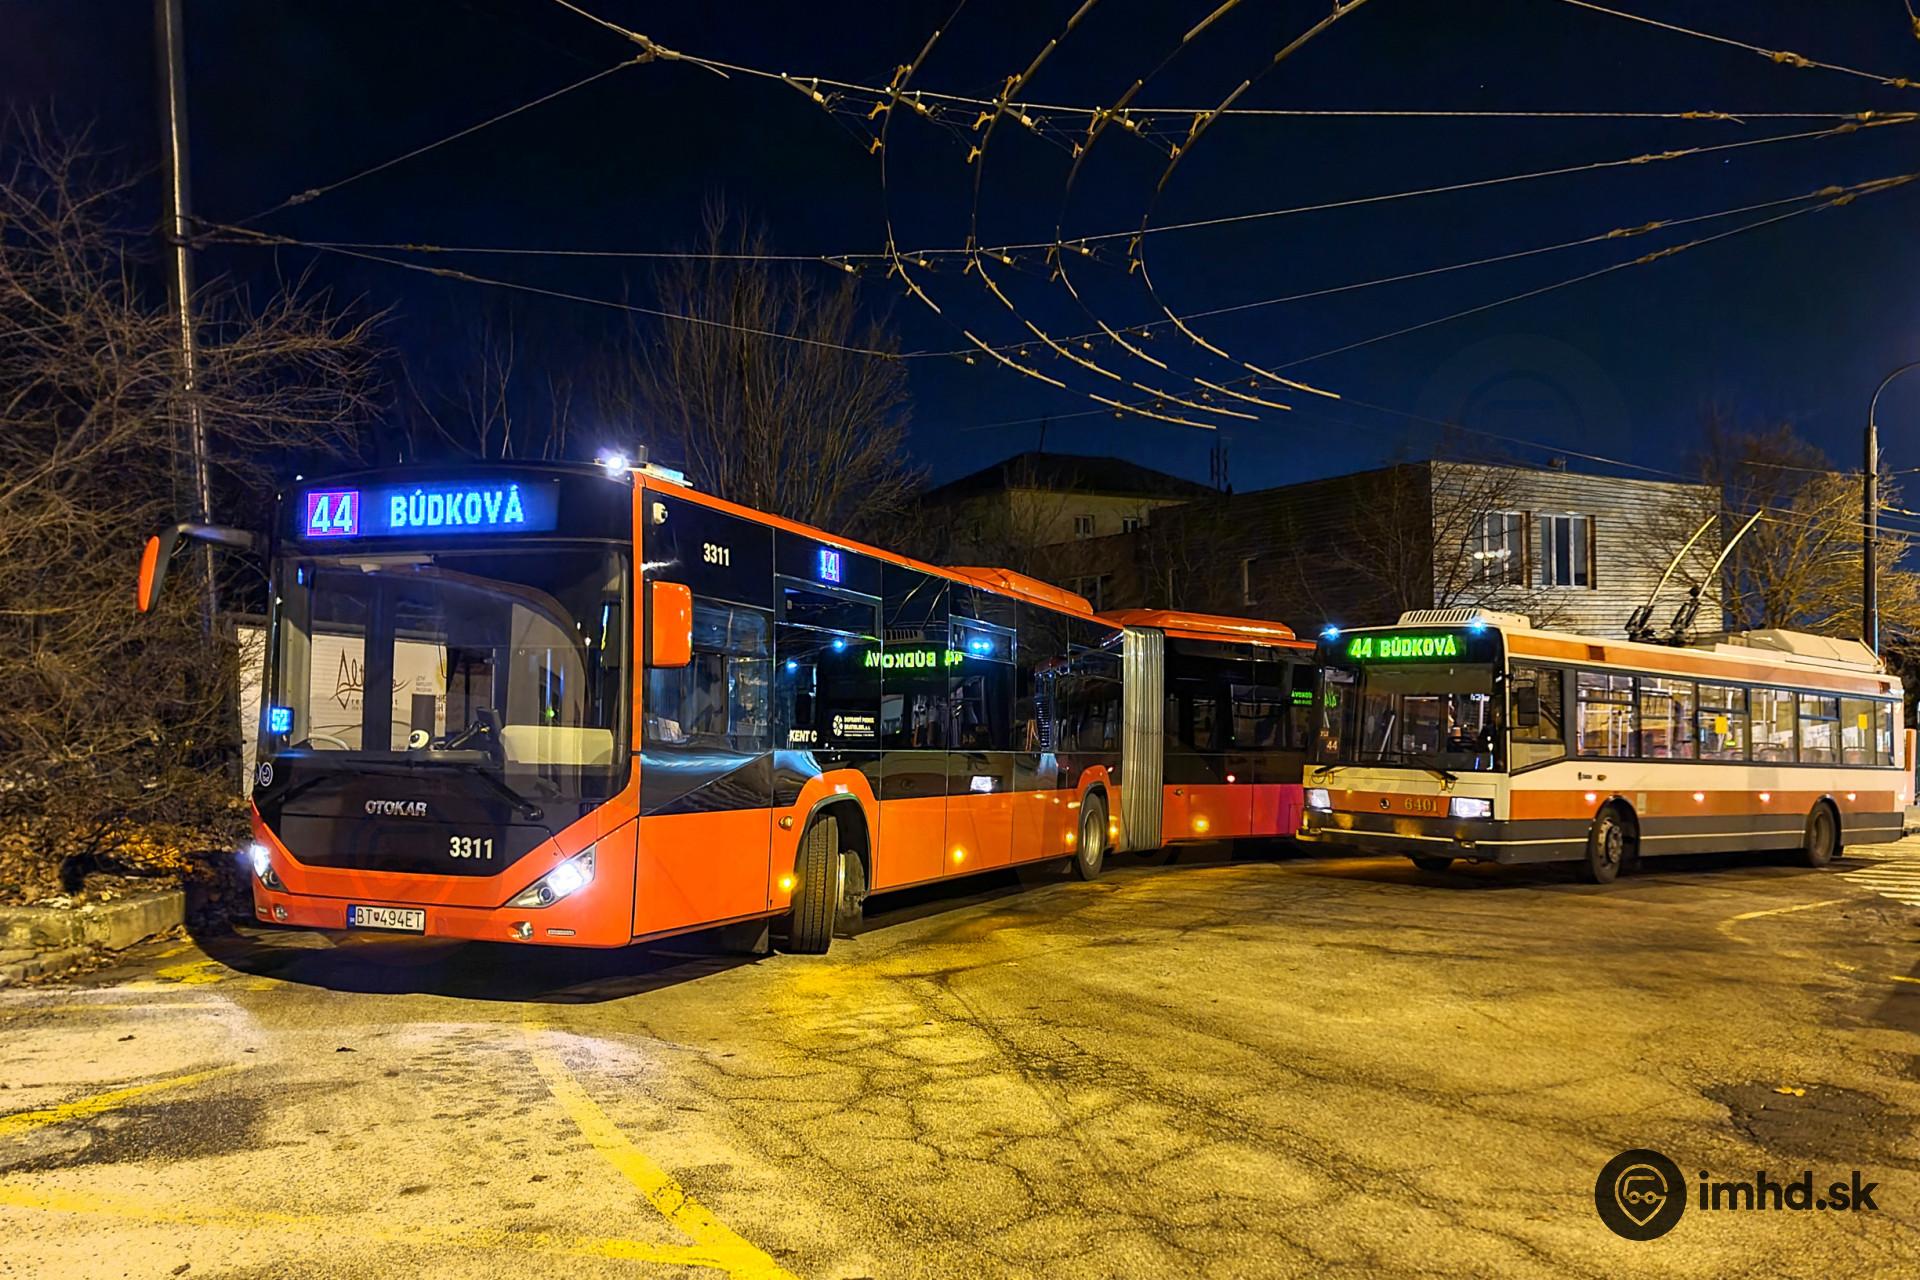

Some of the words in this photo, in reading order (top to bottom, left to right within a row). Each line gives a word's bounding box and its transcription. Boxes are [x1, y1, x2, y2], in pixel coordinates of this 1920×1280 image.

[311, 495, 353, 533] 44
[390, 484, 524, 528] BÚDKOVÁ
[703, 543, 730, 567] 3311
[1351, 638, 1372, 658] 44
[1380, 635, 1456, 657] BÚDKOVÁ
[789, 730, 810, 743] KENT
[811, 731, 818, 743] C
[1326, 740, 1338, 750] 44
[365, 800, 428, 816] OTOKAR
[1404, 797, 1438, 813] 6401
[449, 836, 493, 859] 3311
